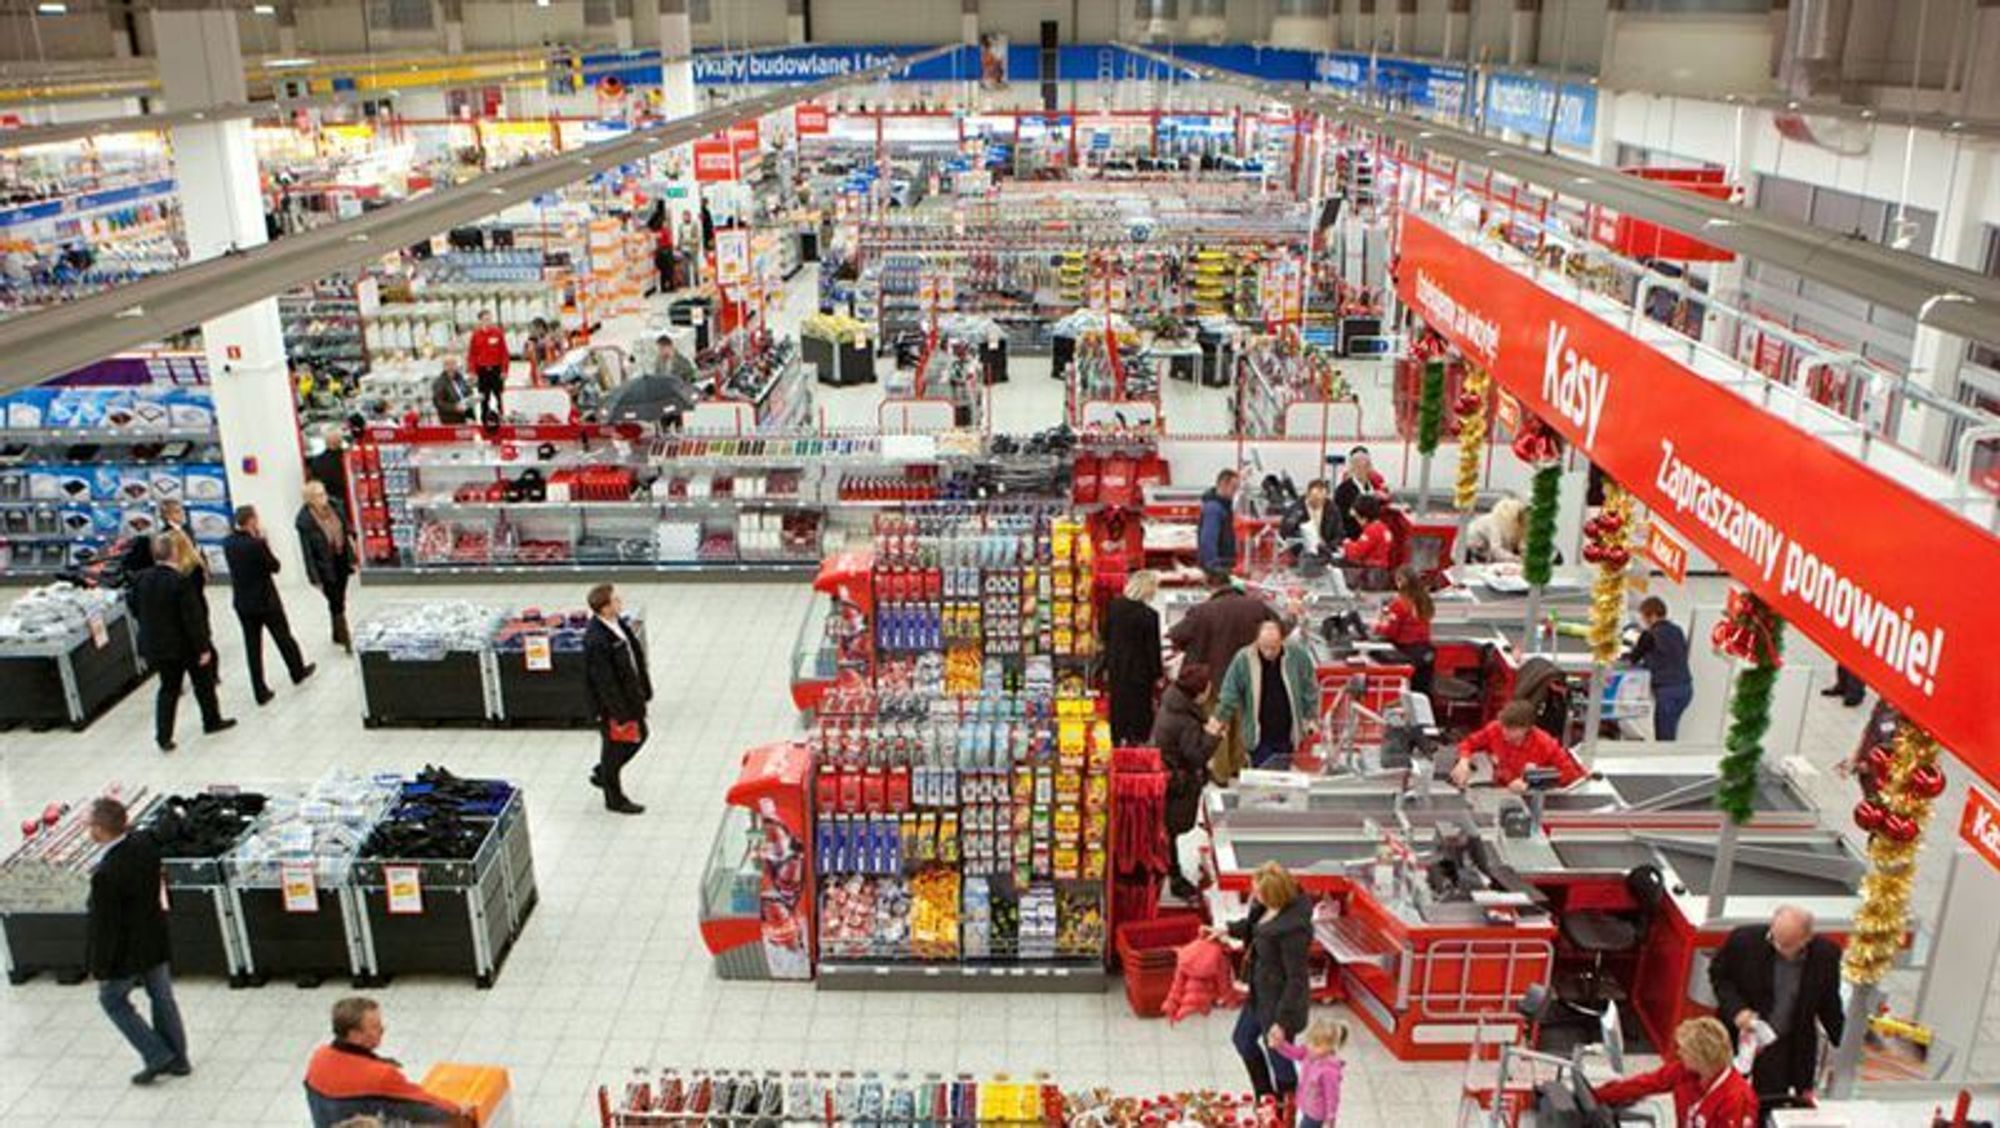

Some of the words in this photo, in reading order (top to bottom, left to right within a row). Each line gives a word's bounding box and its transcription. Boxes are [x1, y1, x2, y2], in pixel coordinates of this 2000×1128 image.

[750, 53, 850, 75] budowlane
[865, 52, 912, 78] fary
[1542, 319, 1609, 450] Kasy
[1655, 438, 1784, 582] Zapraszamy
[1781, 540, 1945, 697] ponownie!
